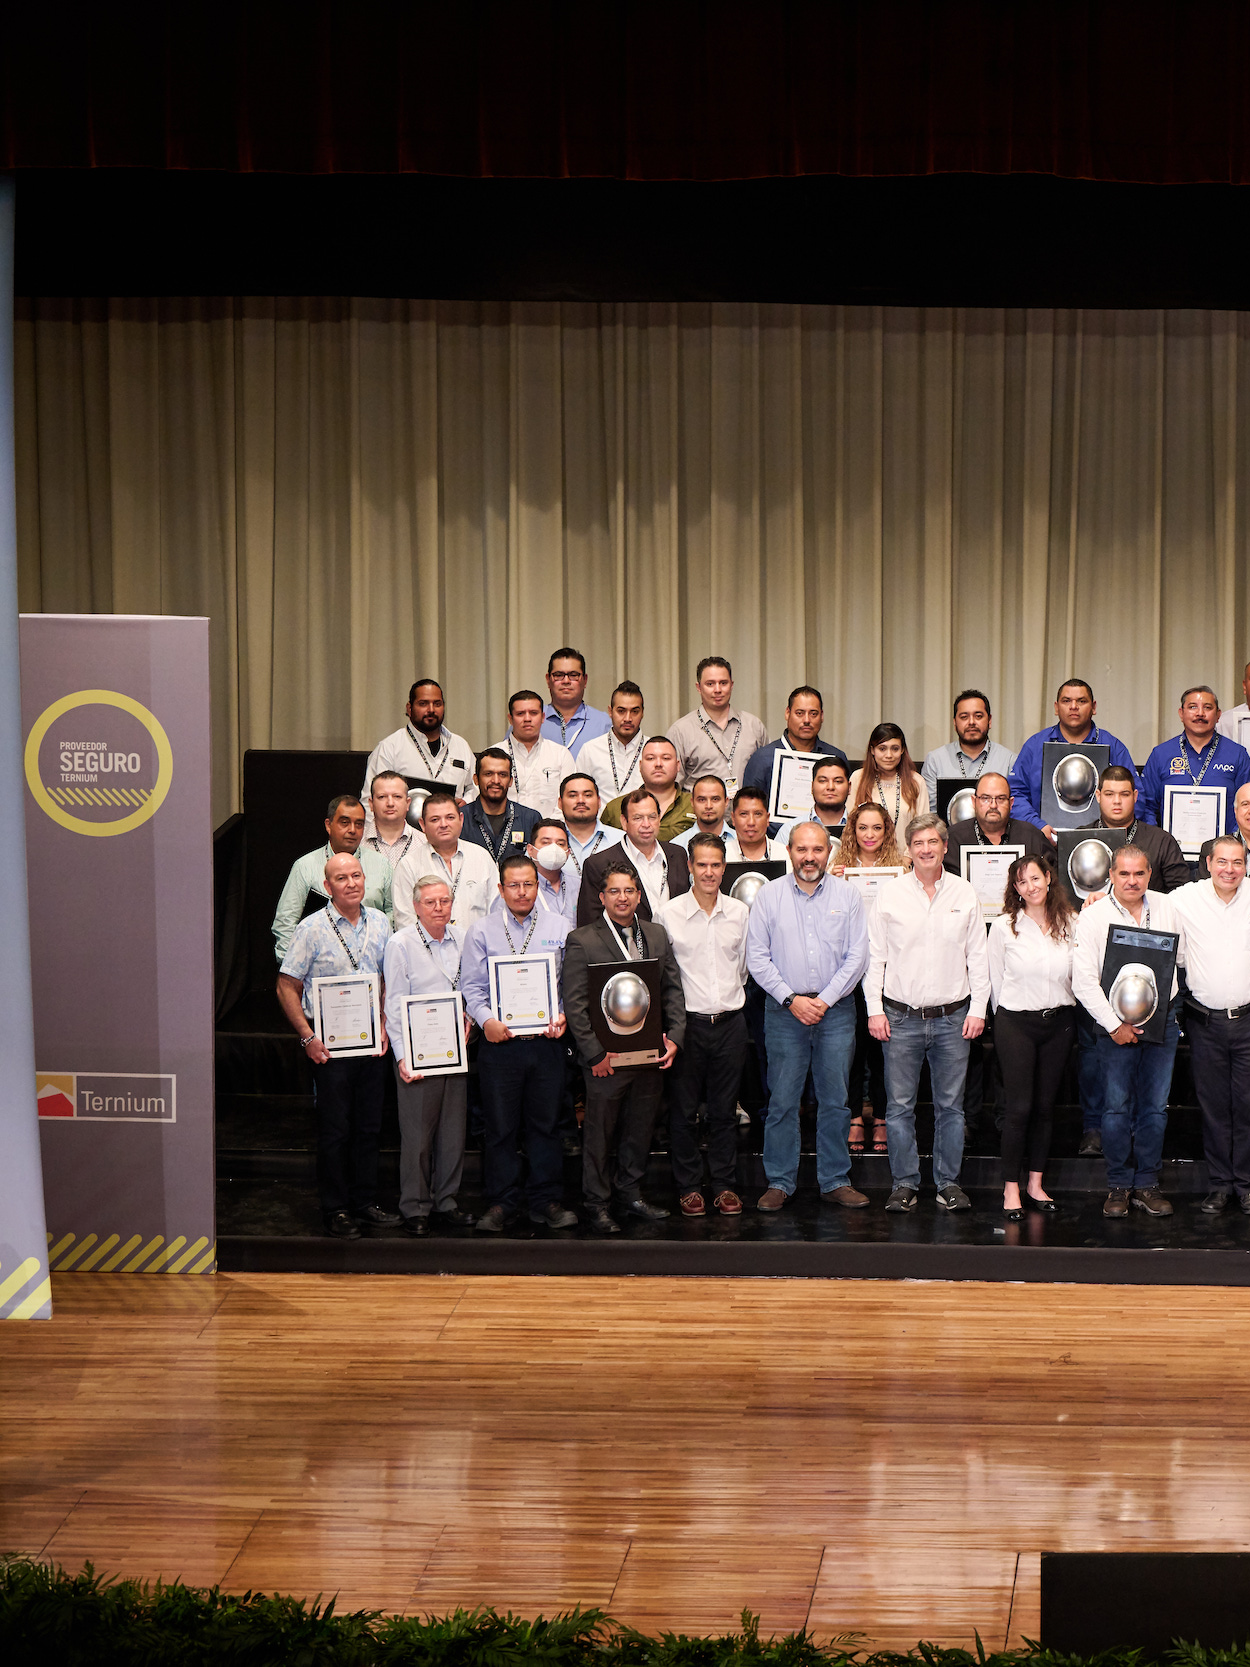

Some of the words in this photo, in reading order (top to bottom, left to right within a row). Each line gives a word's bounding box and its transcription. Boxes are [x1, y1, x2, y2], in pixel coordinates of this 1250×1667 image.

[60, 741, 107, 751] PROVEEDOR
[60, 751, 141, 773] SEGURO
[60, 773, 98, 783] TERNIUM
[80, 1090, 166, 1113] Ternium
